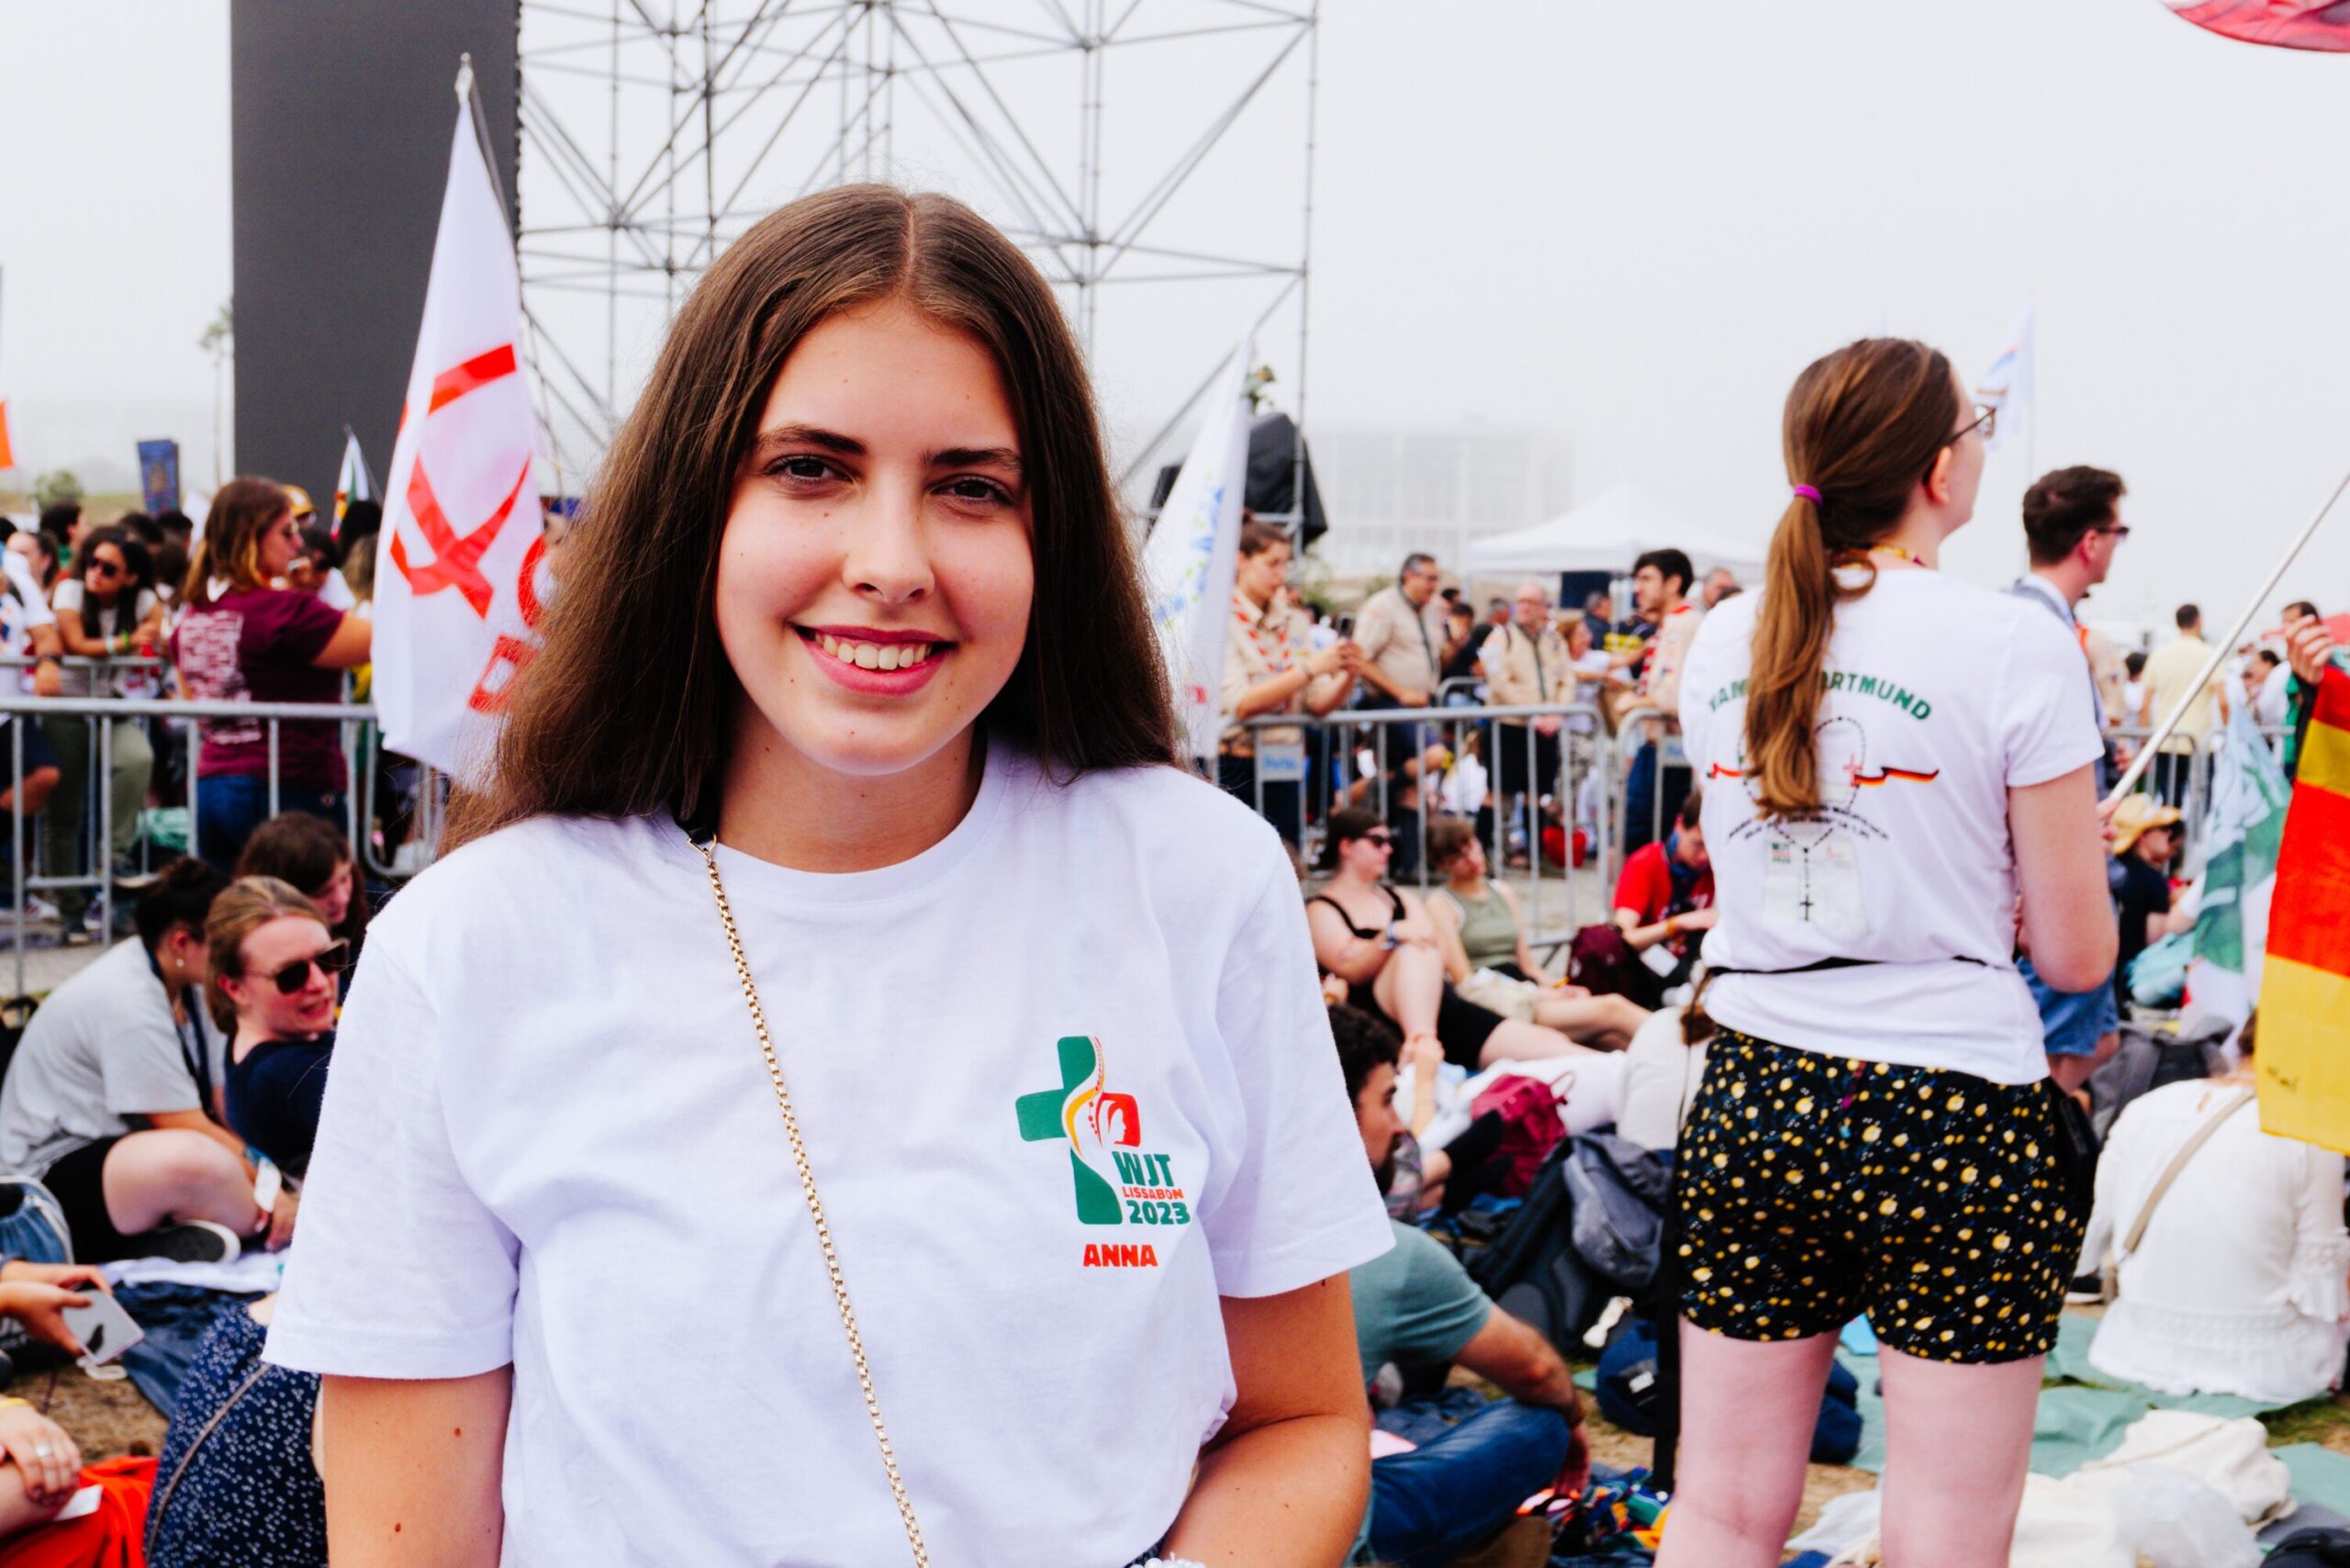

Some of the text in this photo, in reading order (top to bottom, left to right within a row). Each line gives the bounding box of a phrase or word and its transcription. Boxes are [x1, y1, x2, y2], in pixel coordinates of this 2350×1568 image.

[1819, 671, 1933, 721] ORTMUND
[1112, 1150, 1174, 1187] WJT
[1122, 1186, 1184, 1201] LISSABON
[1125, 1200, 1191, 1226] 2023
[1082, 1243, 1159, 1268] ANNA
